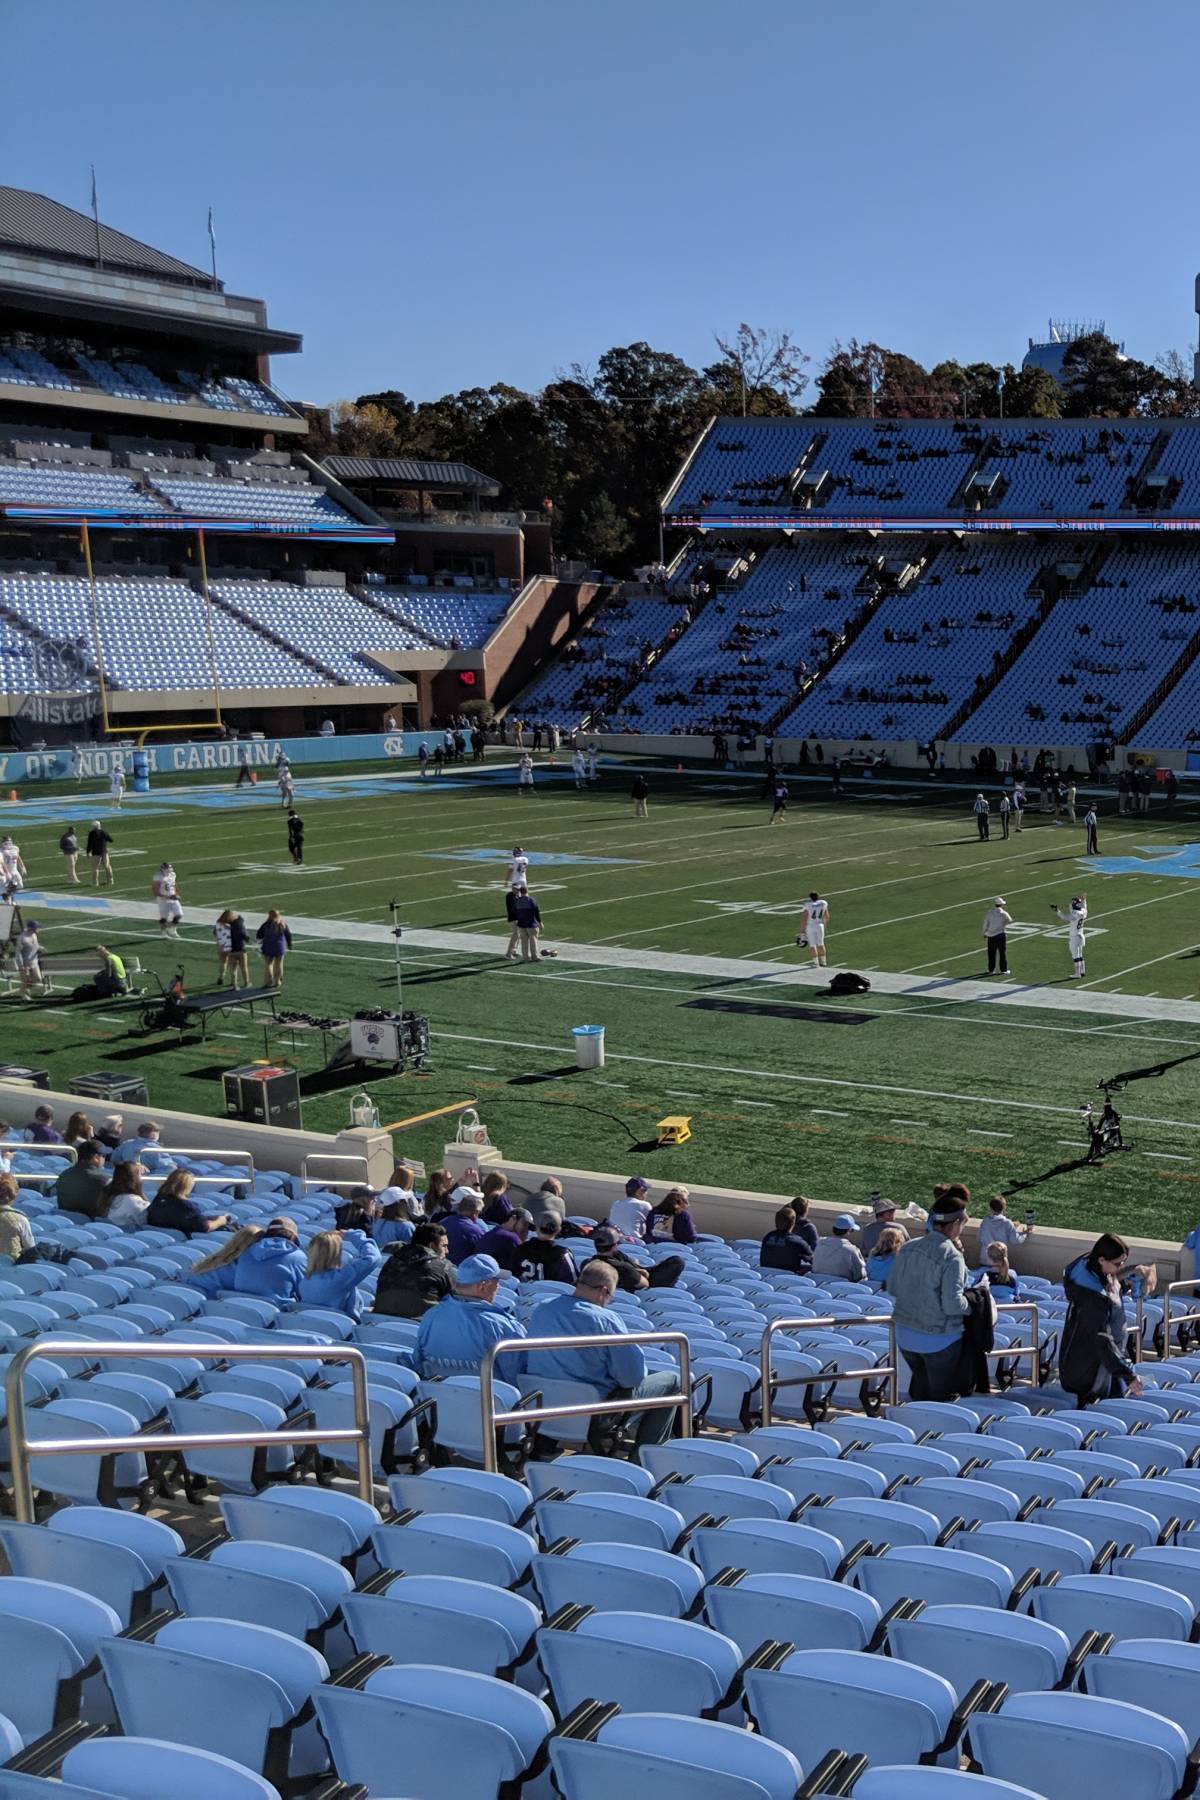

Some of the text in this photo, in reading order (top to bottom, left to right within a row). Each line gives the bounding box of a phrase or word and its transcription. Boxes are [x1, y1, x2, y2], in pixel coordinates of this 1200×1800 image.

[21, 693, 104, 725] Allstate
[26, 753, 57, 779] OF
[173, 742, 283, 770] CAROLINA
[520, 1258, 545, 1281] 21
